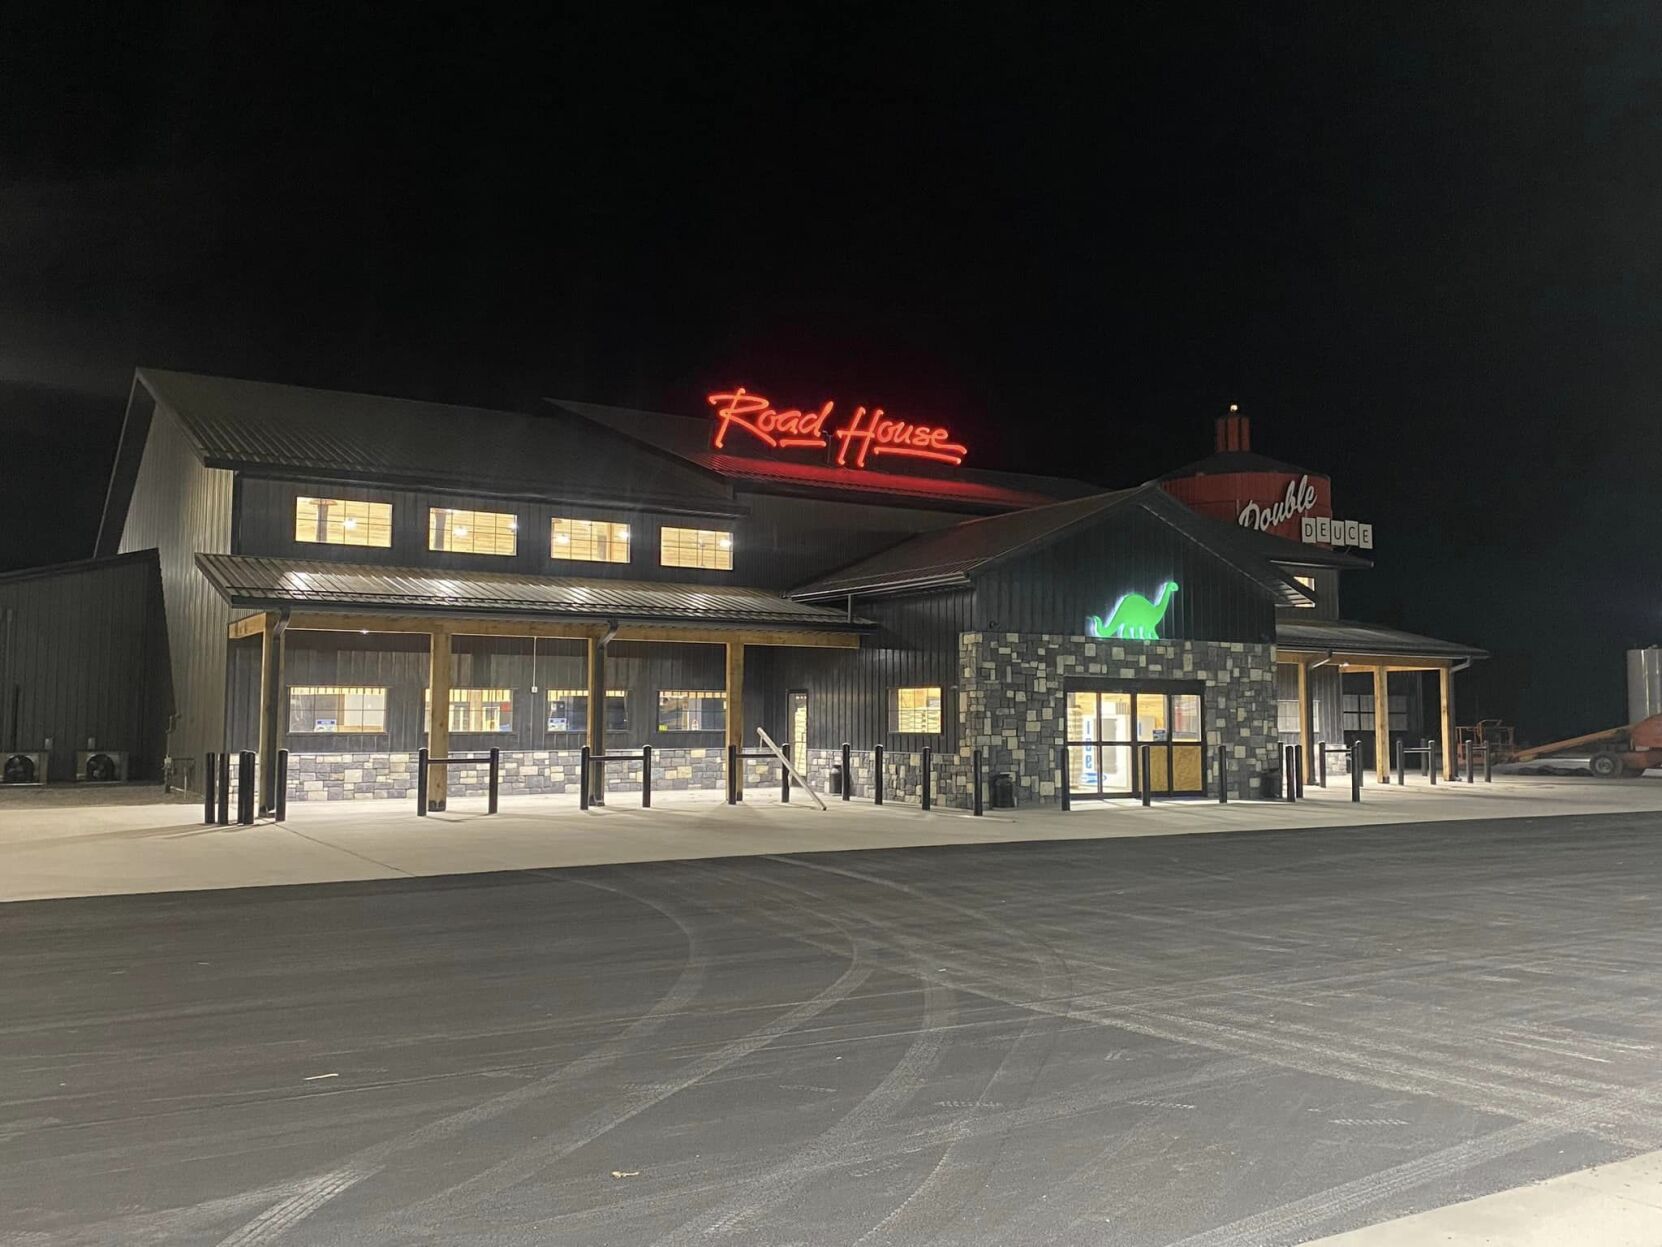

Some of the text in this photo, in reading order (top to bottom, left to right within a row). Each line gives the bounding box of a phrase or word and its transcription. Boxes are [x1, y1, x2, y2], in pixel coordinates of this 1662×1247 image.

[708, 387, 967, 467] Road House
[1238, 474, 1318, 531] Double
[1304, 521, 1370, 545] DEUCE
